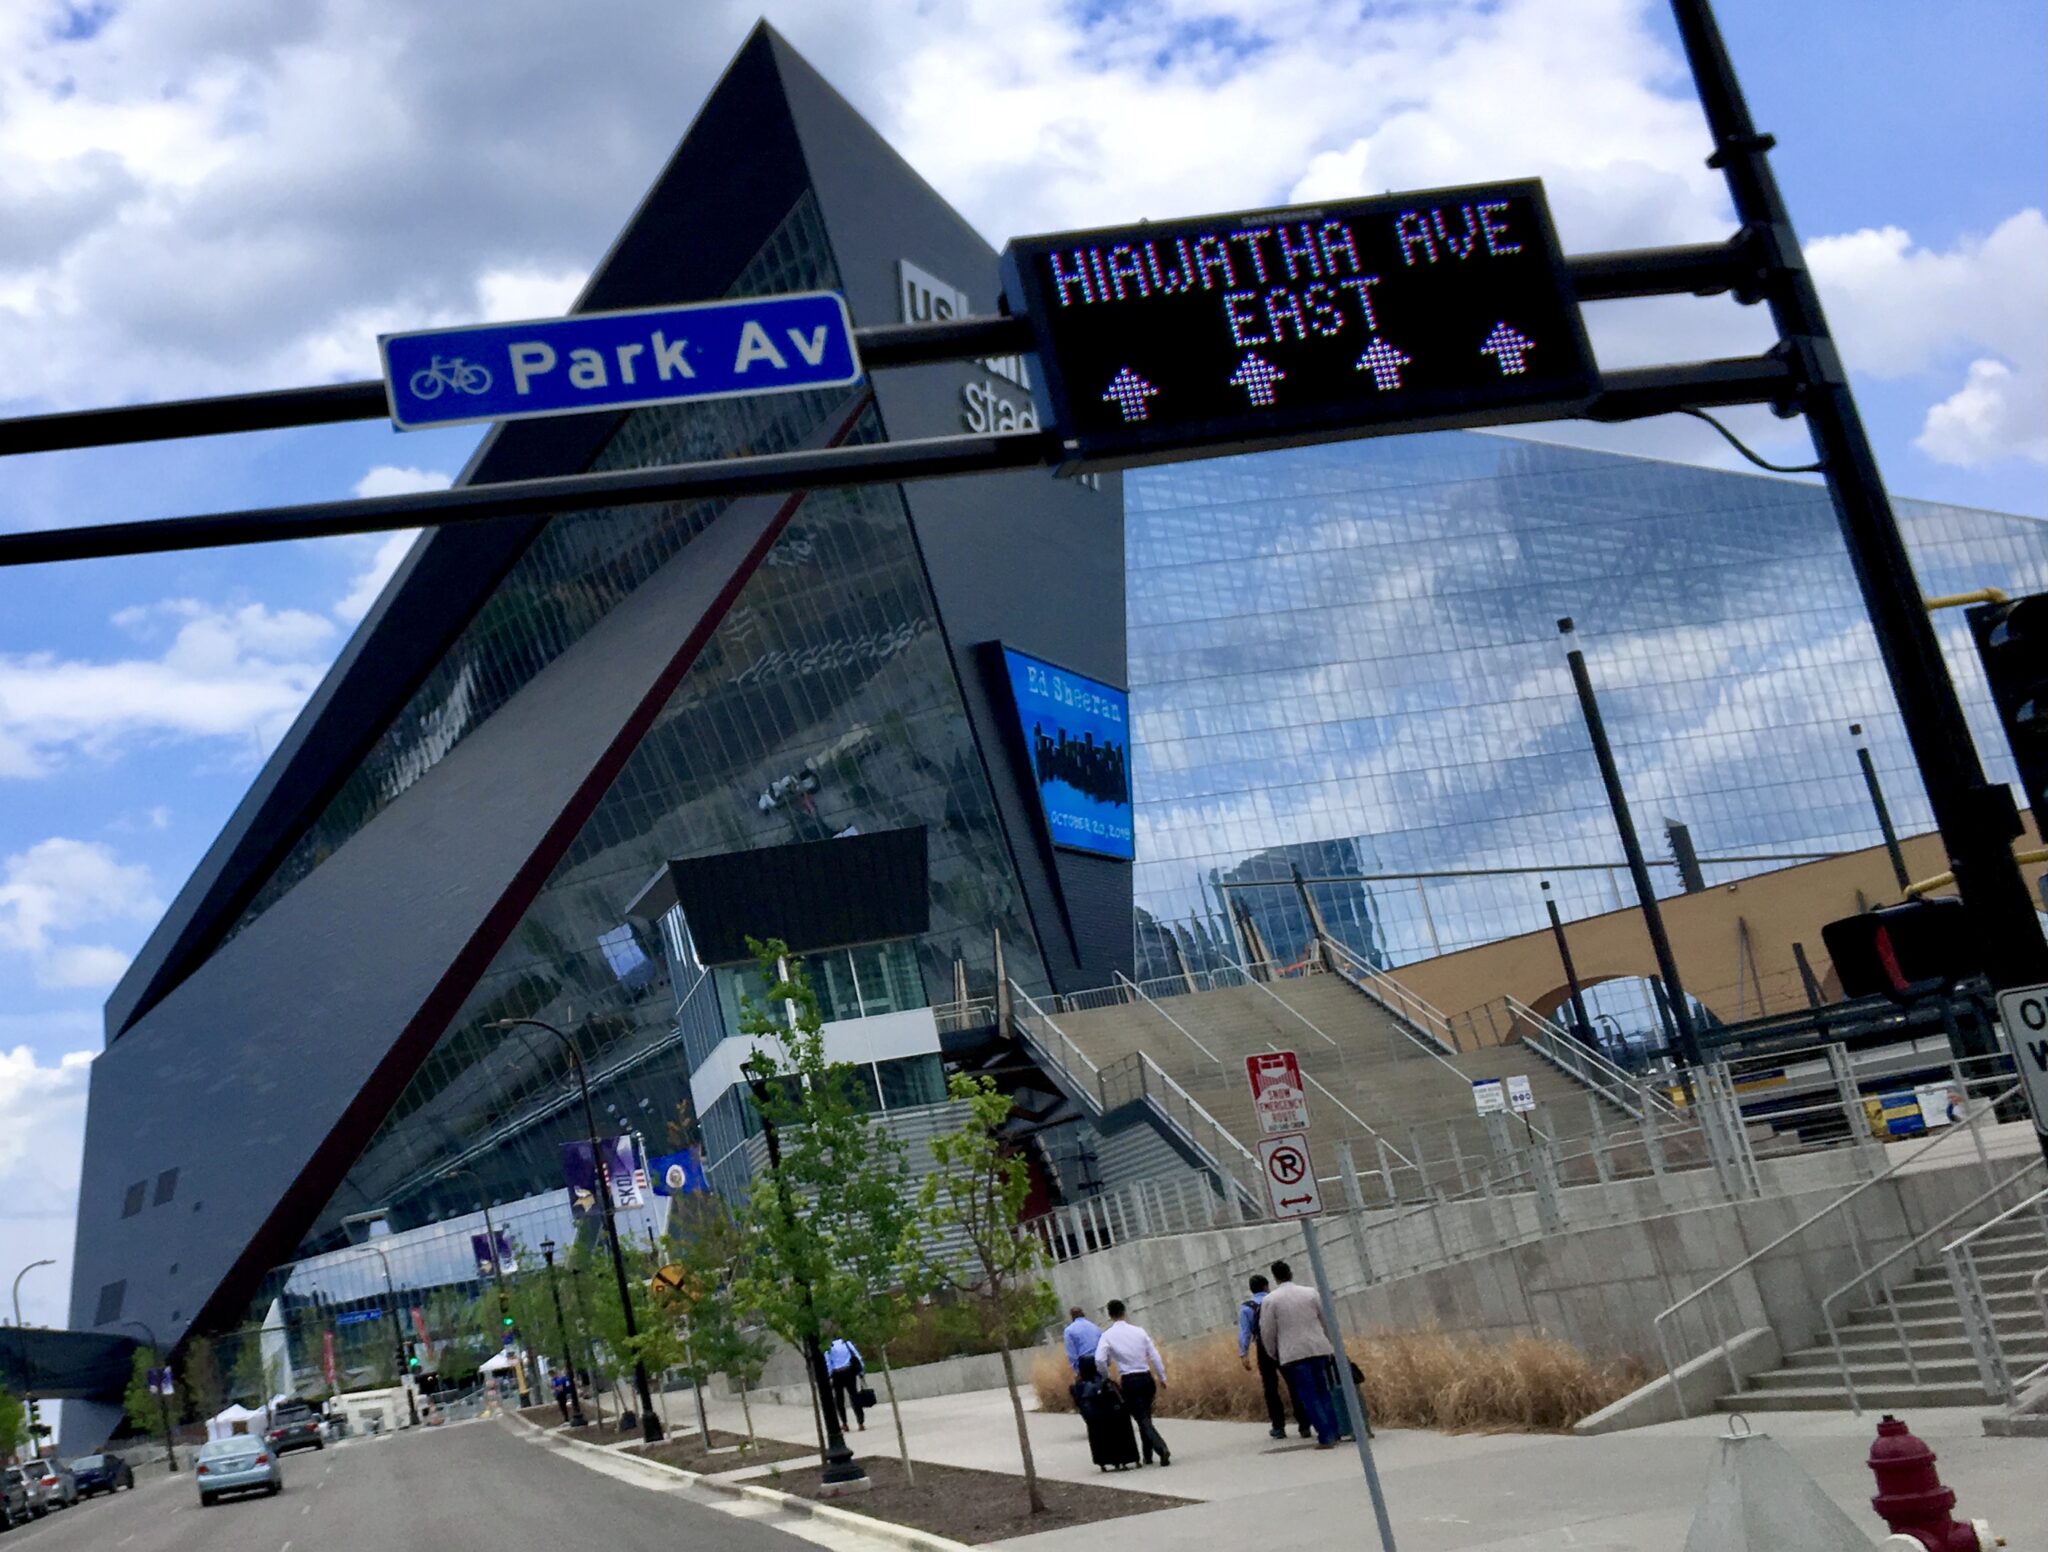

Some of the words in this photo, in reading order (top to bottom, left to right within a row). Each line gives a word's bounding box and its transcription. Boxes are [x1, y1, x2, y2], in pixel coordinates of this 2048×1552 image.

[1050, 219, 1362, 306] HIAWATHA
[1395, 202, 1523, 266] AVE
[1222, 276, 1380, 346] EAST
[508, 330, 695, 395] Park
[734, 320, 829, 374] Av
[965, 381, 1039, 434] Stad
[1027, 666, 1049, 697] Ed
[1052, 675, 1122, 722] Sheeran
[1051, 810, 1092, 832] OCTOBER
[2020, 997, 2048, 1031] O
[1258, 1099, 1304, 1113] EMERGENCY
[1267, 1088, 1291, 1100] SNOW
[1271, 1111, 1298, 1123] ROUTE
